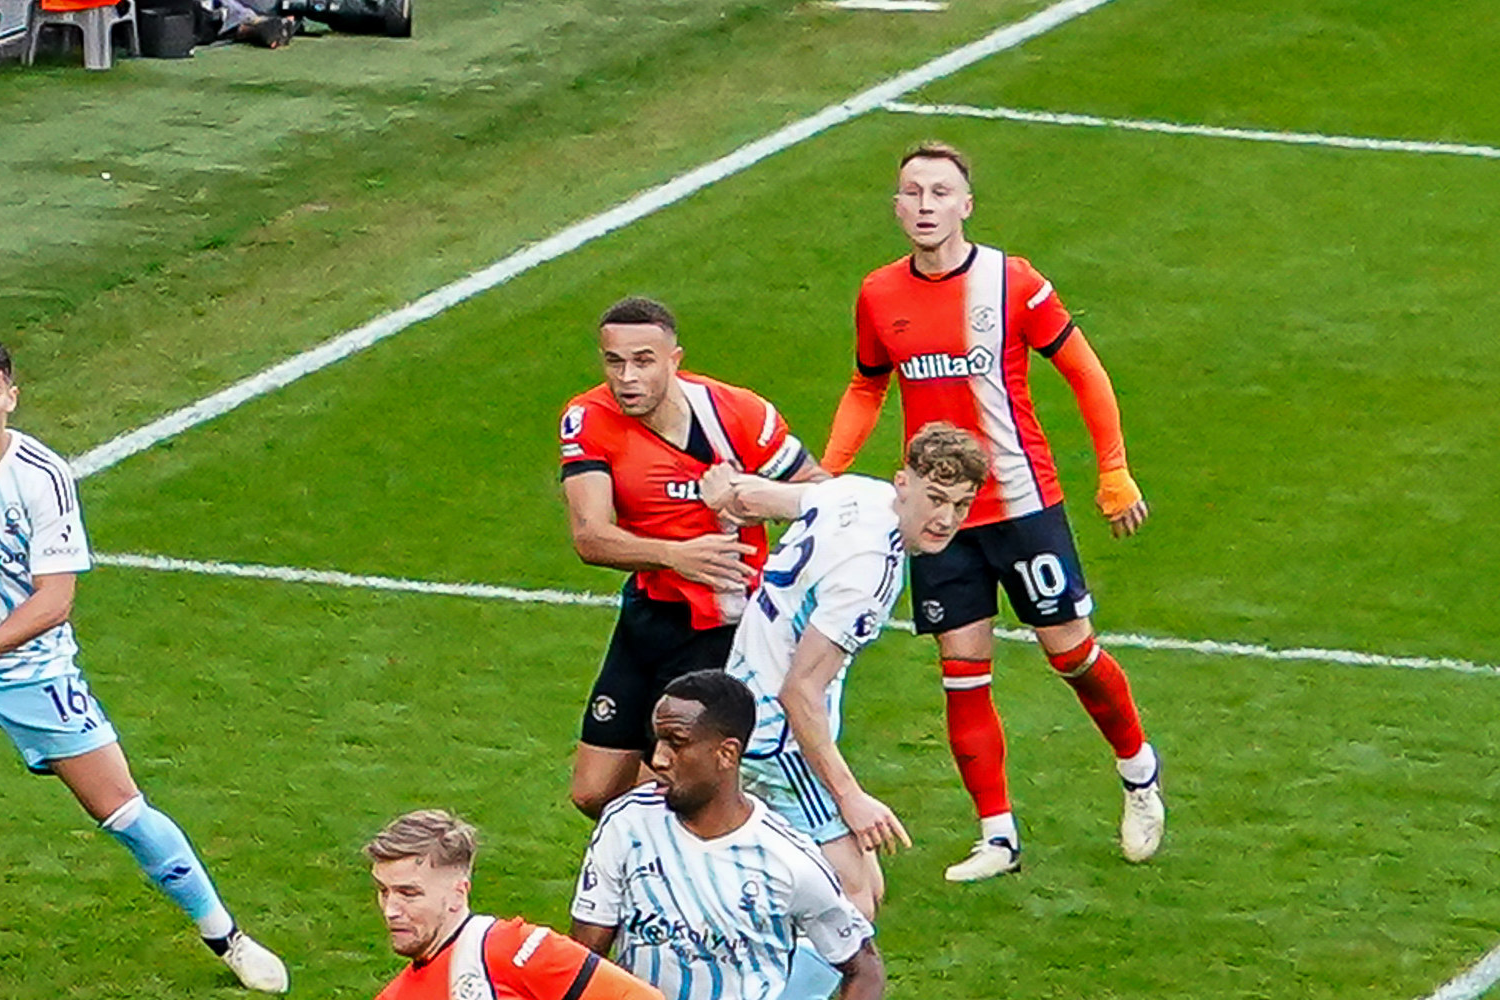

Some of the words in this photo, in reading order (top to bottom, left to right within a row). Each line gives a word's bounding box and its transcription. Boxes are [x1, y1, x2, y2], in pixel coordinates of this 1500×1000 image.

[900, 353, 969, 380] utilita
[1014, 553, 1067, 601] 10
[42, 675, 88, 722] 16
